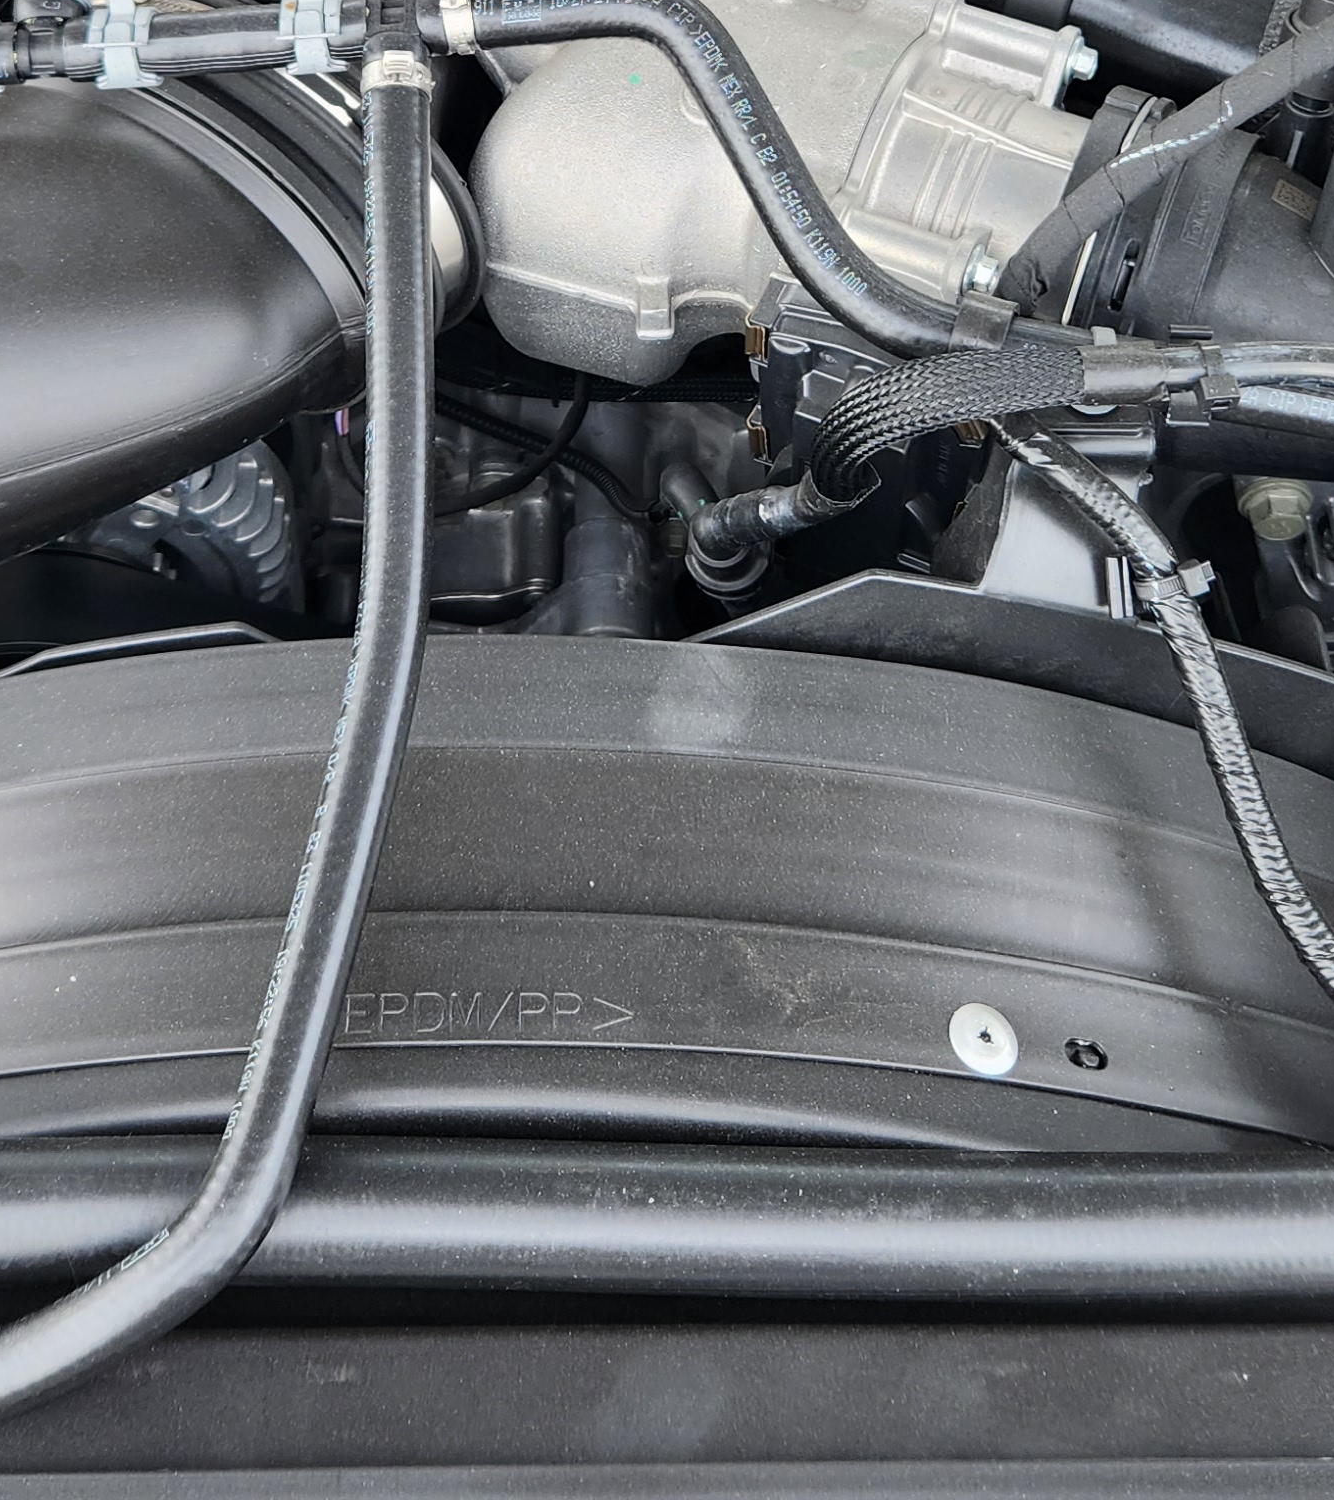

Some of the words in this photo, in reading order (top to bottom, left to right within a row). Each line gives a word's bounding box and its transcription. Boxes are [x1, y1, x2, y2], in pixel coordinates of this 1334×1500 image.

[718, 73, 744, 100] MEX
[730, 97, 759, 131] RR/L
[750, 132, 768, 146] C
[755, 145, 779, 167] B2
[770, 171, 813, 230] 01:54:50
[803, 227, 842, 271] K119N
[835, 266, 869, 298] 1000
[1268, 389, 1295, 411] CIP
[285, 864, 313, 932] 1105325
